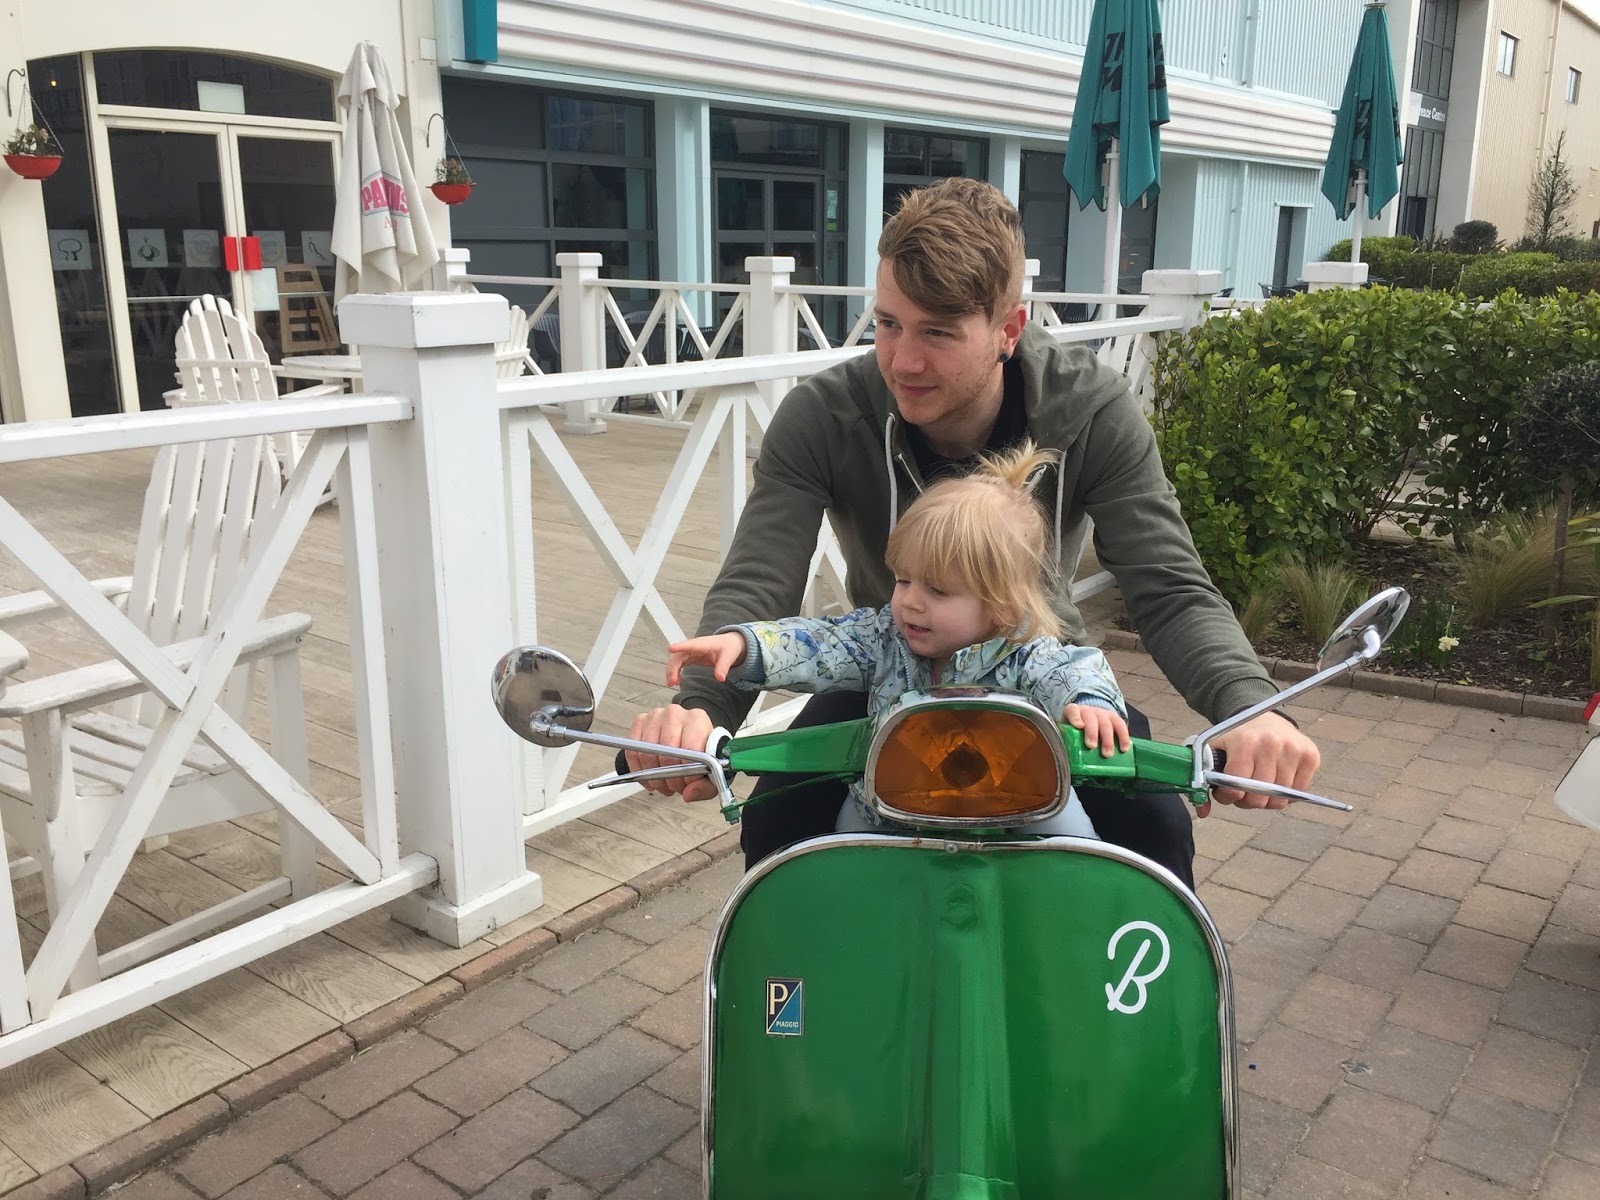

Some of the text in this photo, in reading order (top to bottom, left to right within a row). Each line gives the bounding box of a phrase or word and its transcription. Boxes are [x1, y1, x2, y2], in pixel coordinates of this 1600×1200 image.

[1105, 920, 1170, 1014] B
[769, 983, 789, 1015] P
[775, 1020, 799, 1028] PIAGGIO
